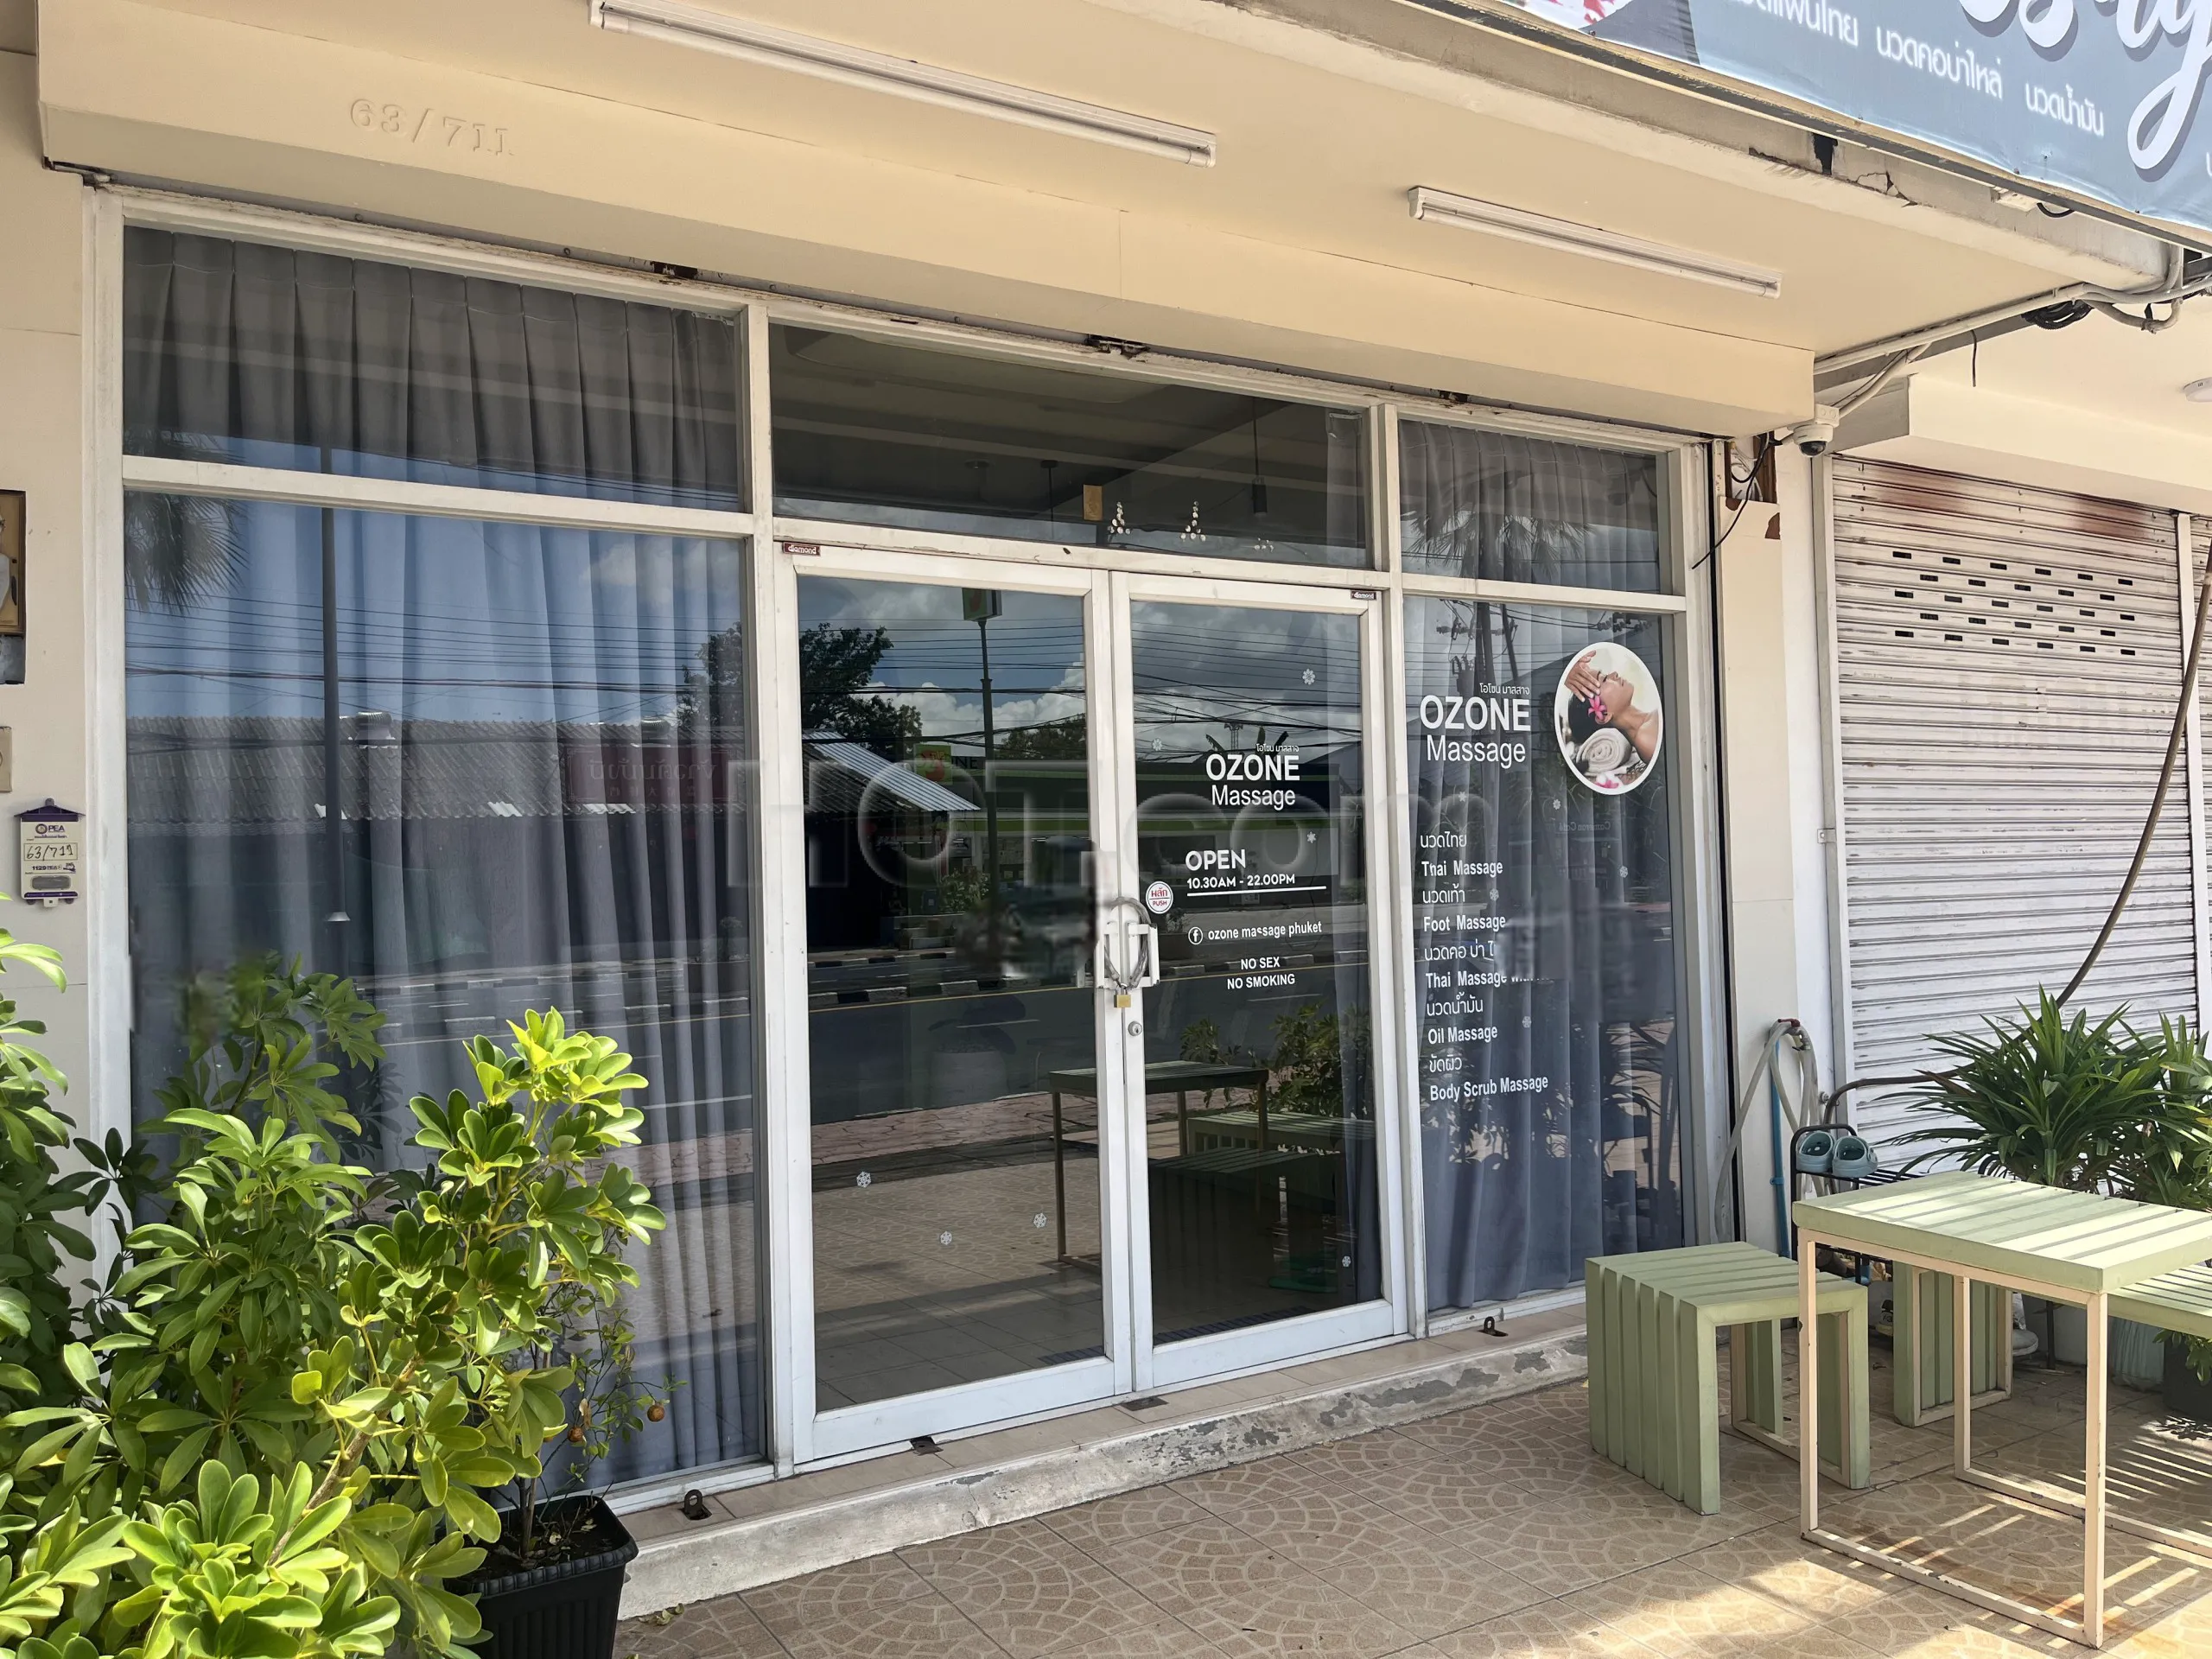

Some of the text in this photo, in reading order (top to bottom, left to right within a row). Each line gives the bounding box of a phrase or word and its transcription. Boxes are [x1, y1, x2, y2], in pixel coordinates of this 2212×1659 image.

[1420, 695, 1531, 732] OZONE
[1427, 734, 1526, 769] Massage
[1205, 753, 1300, 781] OZONE
[1211, 785, 1296, 810] Massage
[1420, 831, 1467, 849] นวดไทย
[1185, 849, 1247, 871] OPEN
[1453, 861, 1503, 878] Massage
[1187, 876, 1236, 889] 10.30AM
[1247, 874, 1296, 887] 22.00PM
[1151, 887, 1168, 898] ผลัก
[1422, 883, 1465, 904] นวดเท้า
[1208, 926, 1239, 940] ozone
[1288, 920, 1323, 938] phuket
[1424, 915, 1506, 932] Foot Massage
[1241, 957, 1281, 969] NO SEX
[1227, 974, 1296, 989] NO SMOKING
[1426, 972, 1451, 988] Thai
[1427, 992, 1484, 1016] นวดน้ำมัน
[1427, 1026, 1498, 1045] Oil Massage
[1429, 1054, 1463, 1073] ขัดผิว
[1430, 1077, 1548, 1103] Body Scrub Massage
